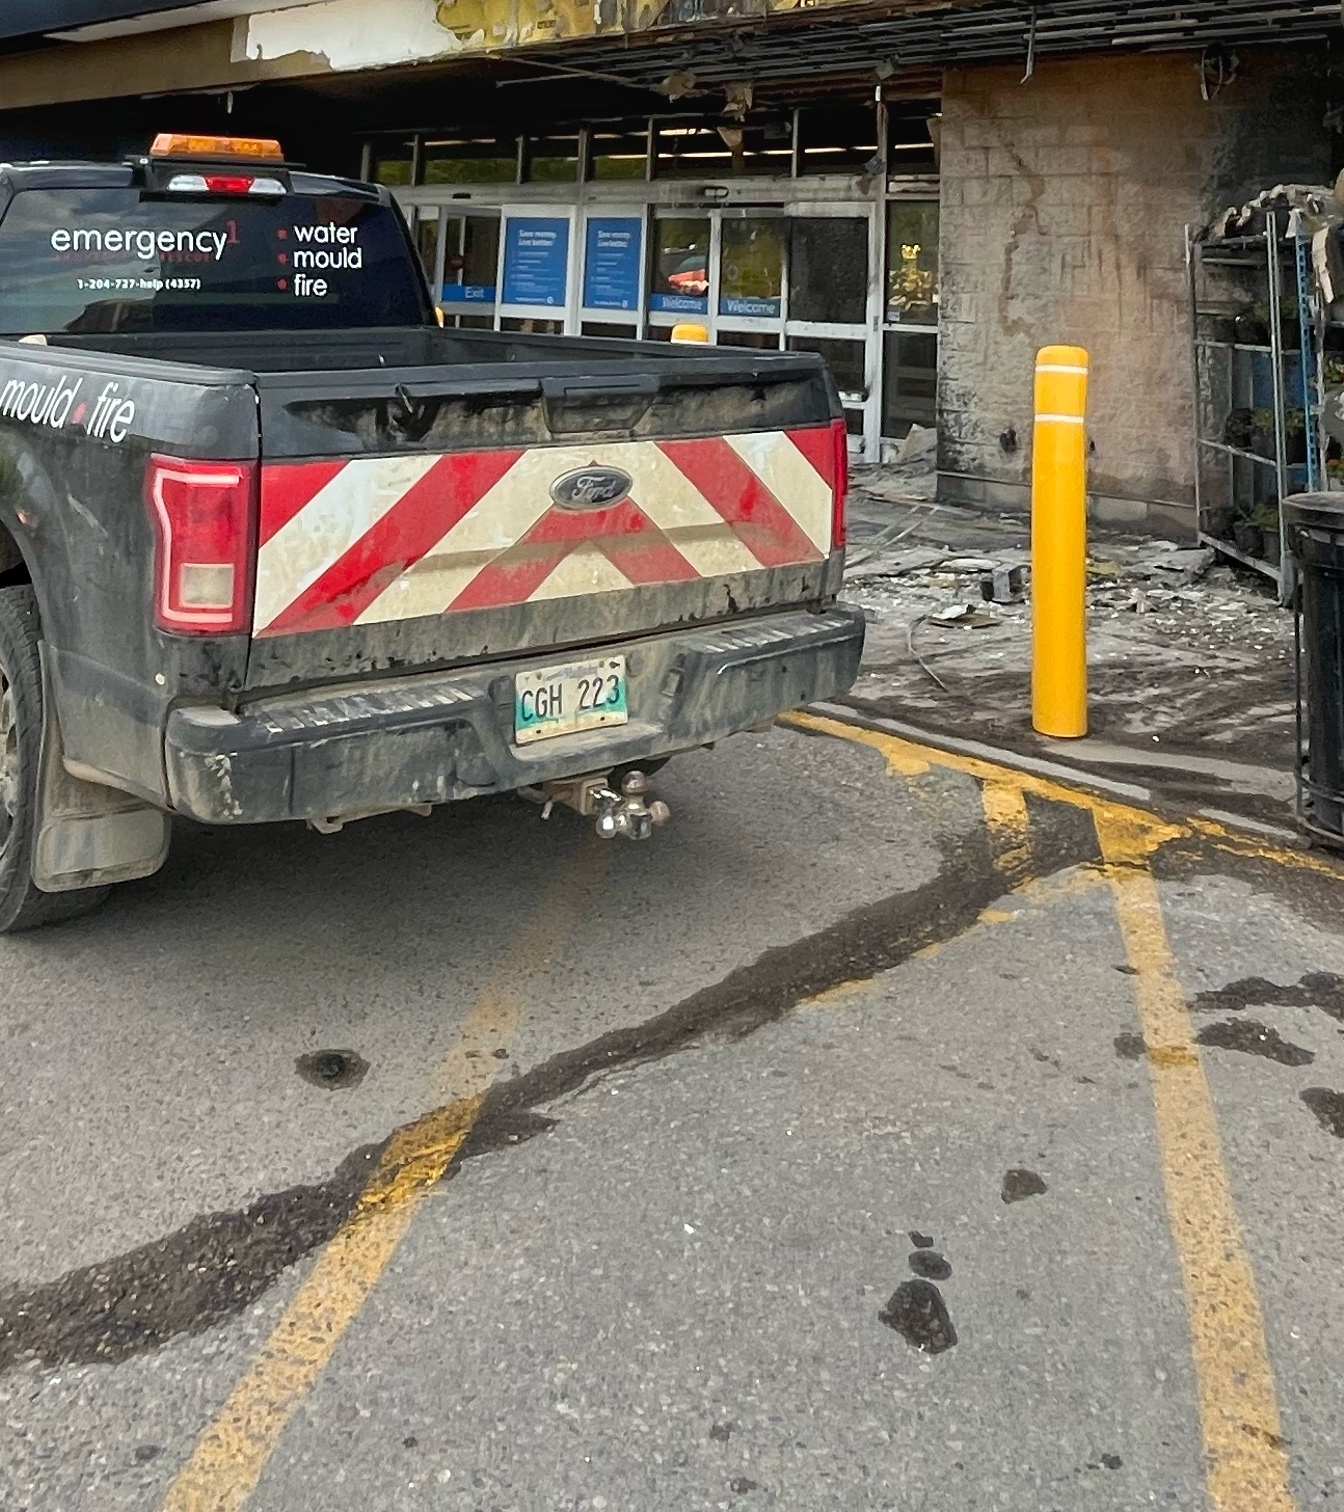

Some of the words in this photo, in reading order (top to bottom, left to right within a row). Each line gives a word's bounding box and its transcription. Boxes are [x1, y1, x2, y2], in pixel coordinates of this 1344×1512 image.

[294, 223, 357, 244] water
[294, 246, 362, 269] mould
[76, 278, 164, 291] 1-204-727-help
[294, 273, 328, 297] fire
[464, 286, 485, 299] Exit
[662, 296, 703, 310] Welcome
[727, 299, 777, 314] Welcome
[86, 381, 135, 443] fire
[572, 476, 617, 500] Ford
[521, 682, 563, 722] CGH
[577, 674, 620, 711] 223
